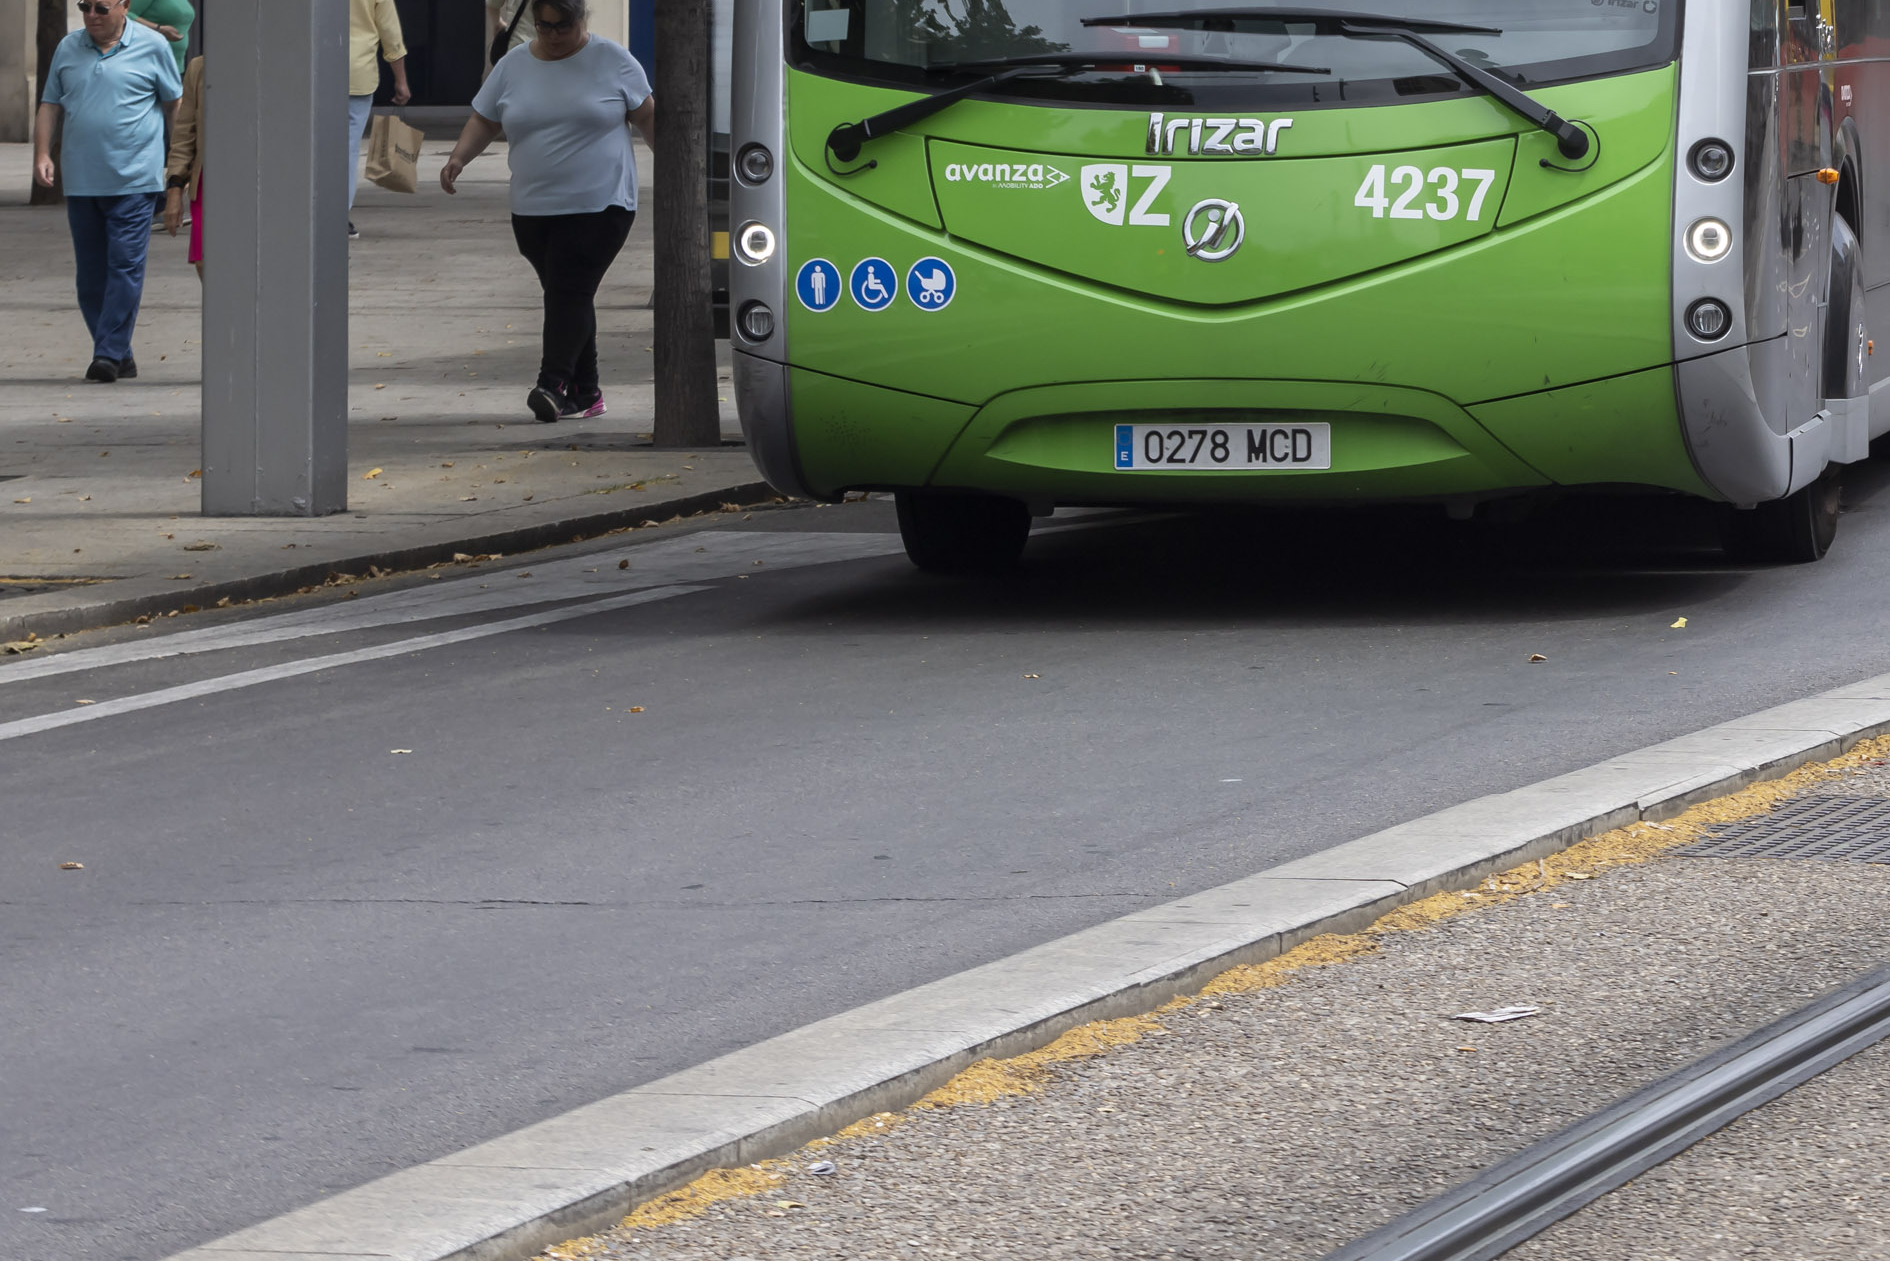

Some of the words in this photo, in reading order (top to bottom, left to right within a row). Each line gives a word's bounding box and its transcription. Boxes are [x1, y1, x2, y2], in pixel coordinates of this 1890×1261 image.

[945, 163, 1044, 182] avanza
[1354, 163, 1496, 222] 4237
[1120, 450, 1129, 461] E
[1143, 430, 1231, 464] 0278
[1246, 428, 1313, 464] MCD
